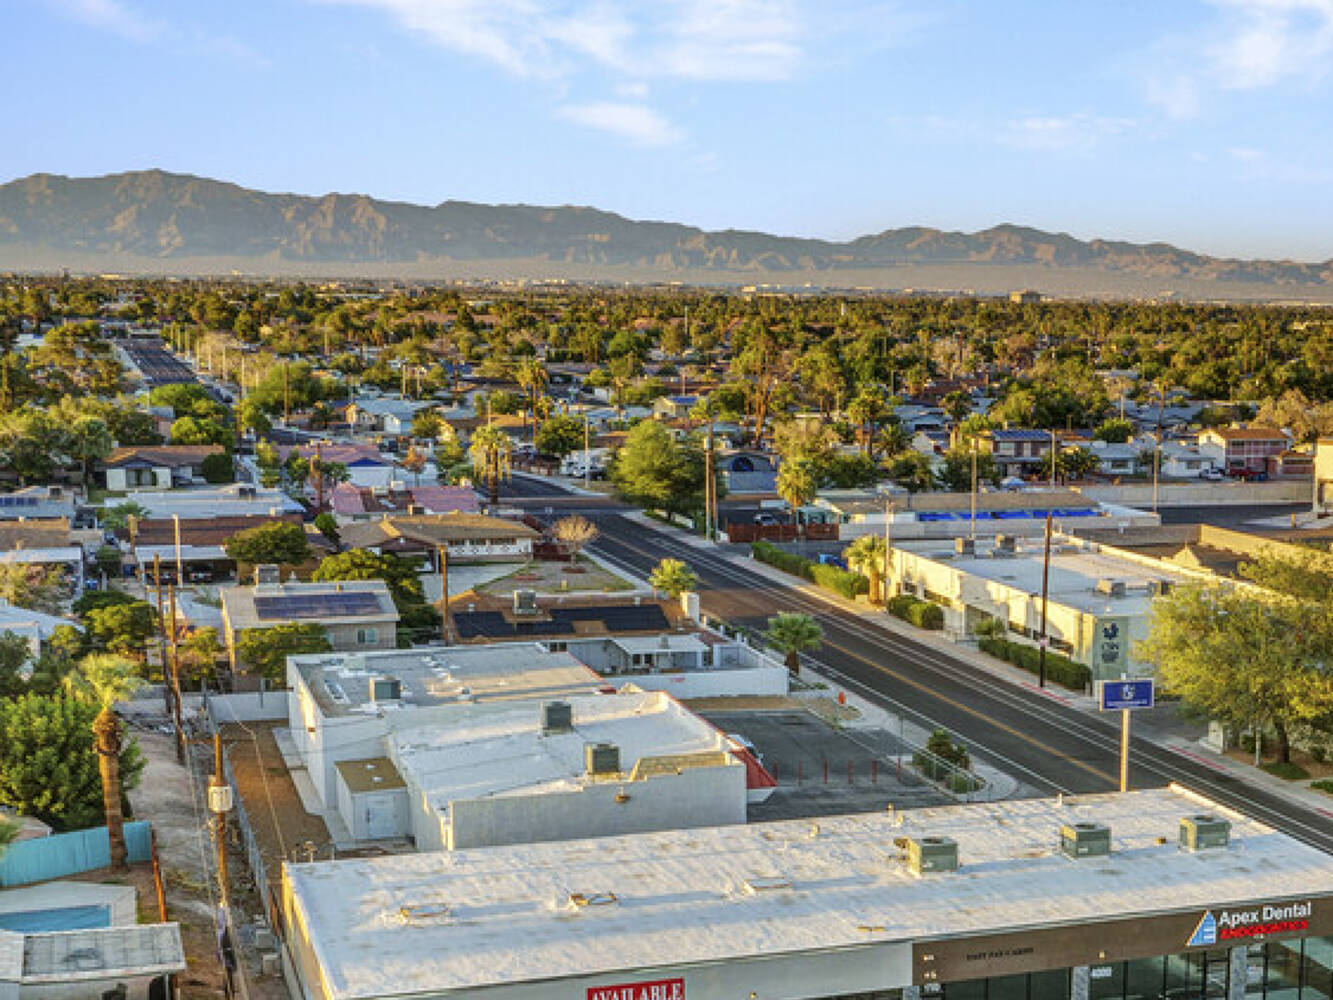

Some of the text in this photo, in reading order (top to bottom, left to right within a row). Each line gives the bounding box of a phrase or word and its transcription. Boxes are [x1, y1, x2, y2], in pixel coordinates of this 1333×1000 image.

[1218, 902, 1311, 928] Apex Dental
[1220, 919, 1309, 940] ENDODONTICS
